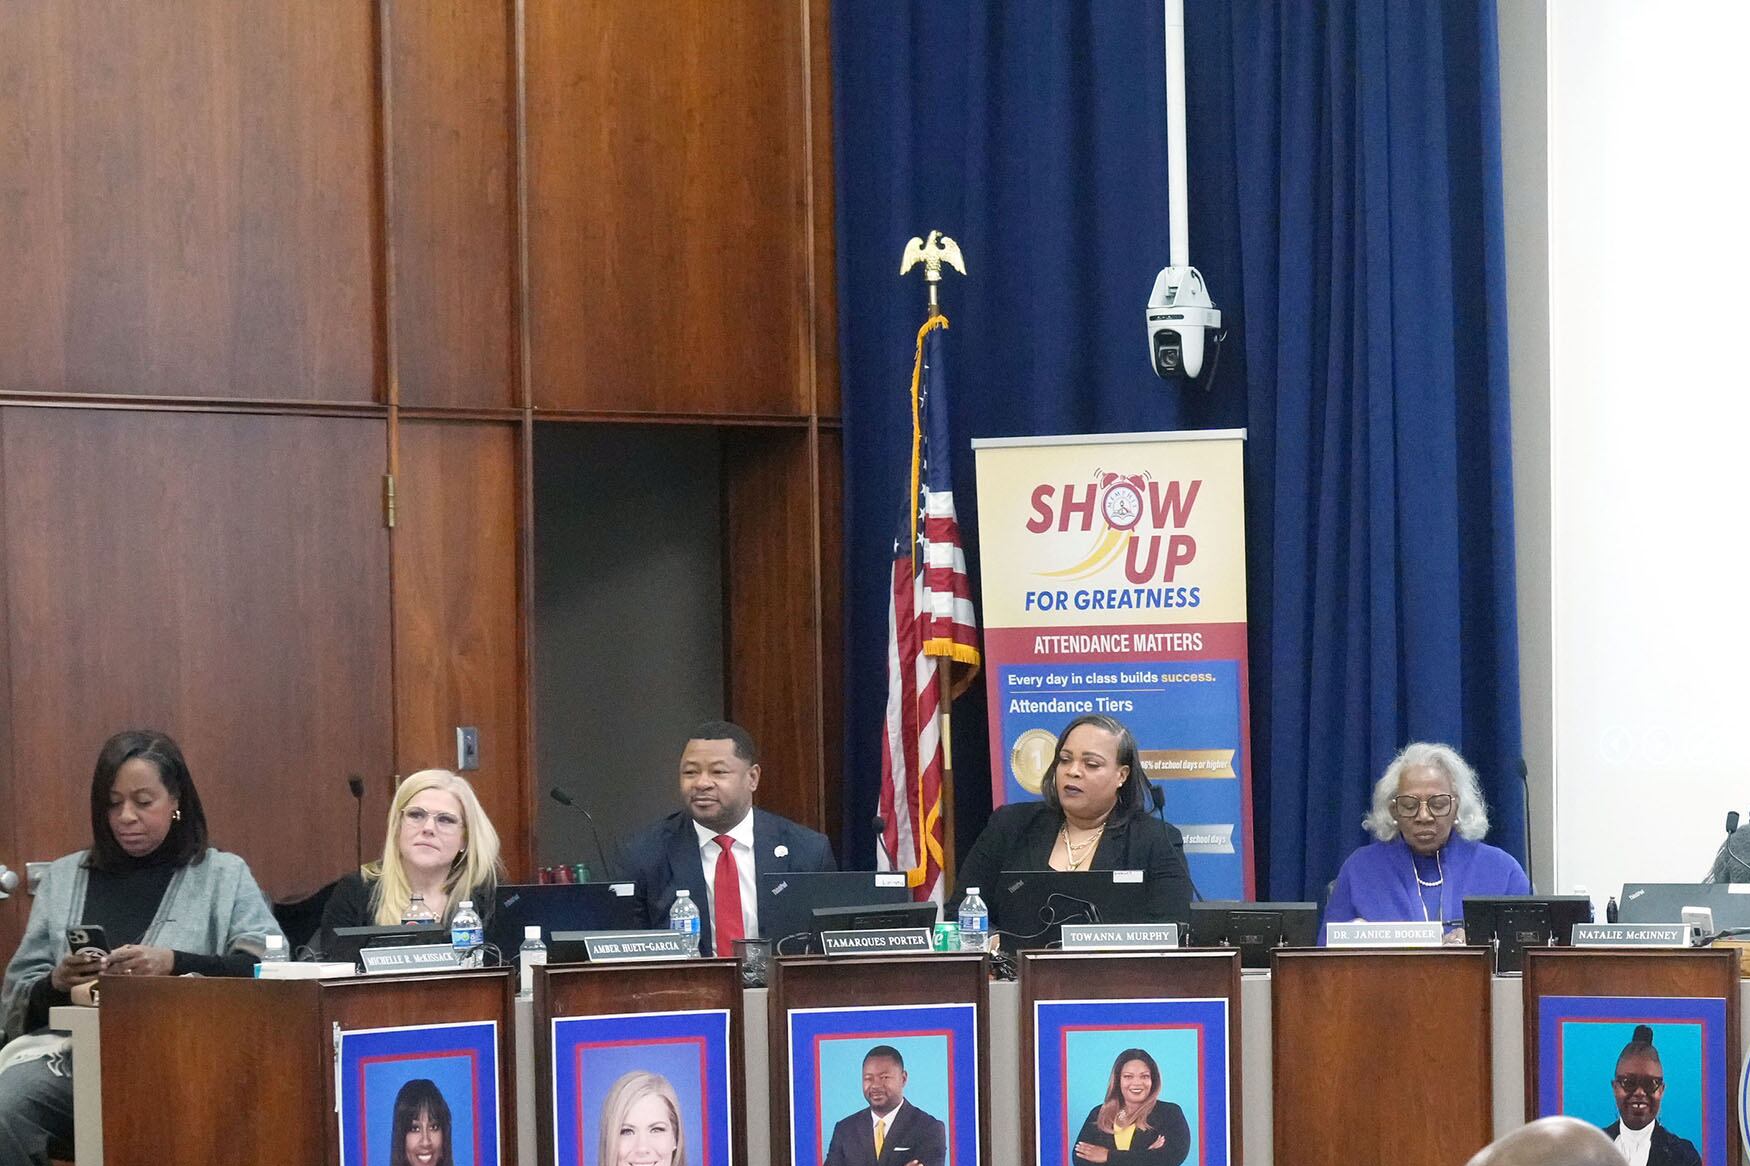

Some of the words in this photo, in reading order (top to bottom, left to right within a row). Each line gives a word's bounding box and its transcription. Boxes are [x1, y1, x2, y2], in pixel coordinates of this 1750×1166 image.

[1125, 534, 1197, 585] UP
[1025, 591, 1068, 611] FOR
[1074, 587, 1200, 610] GREATNESS
[1034, 634, 1129, 654] ATTENDANCE
[1133, 632, 1203, 652] MATTERS
[1008, 674, 1043, 688] Every
[1046, 673, 1069, 687] day
[1071, 672, 1083, 684] in
[1085, 673, 1118, 684] class
[1120, 672, 1159, 683] builds
[1161, 672, 1216, 683] success.
[1009, 698, 1093, 713] Attendance
[1096, 697, 1134, 712] Tiers
[1161, 760, 1183, 770] school
[1183, 760, 1198, 771] days
[1206, 759, 1228, 771] higher
[1189, 834, 1211, 844] school
[1210, 834, 1226, 845] days
[1071, 932, 1122, 942] TOWANNA
[1126, 931, 1170, 941] MURPHY
[1333, 930, 1350, 940] DR.
[1353, 930, 1391, 940] JANICE
[1394, 929, 1435, 939] BOOKER
[1578, 930, 1623, 940] NATALIE
[1626, 930, 1679, 941] McKINNEY
[593, 943, 621, 954] AMBER
[622, 941, 680, 953] HUETT-GARCIA
[827, 937, 886, 948] TAMARQUES
[888, 935, 926, 946] PORTER
[367, 954, 404, 966] MICHELLE
